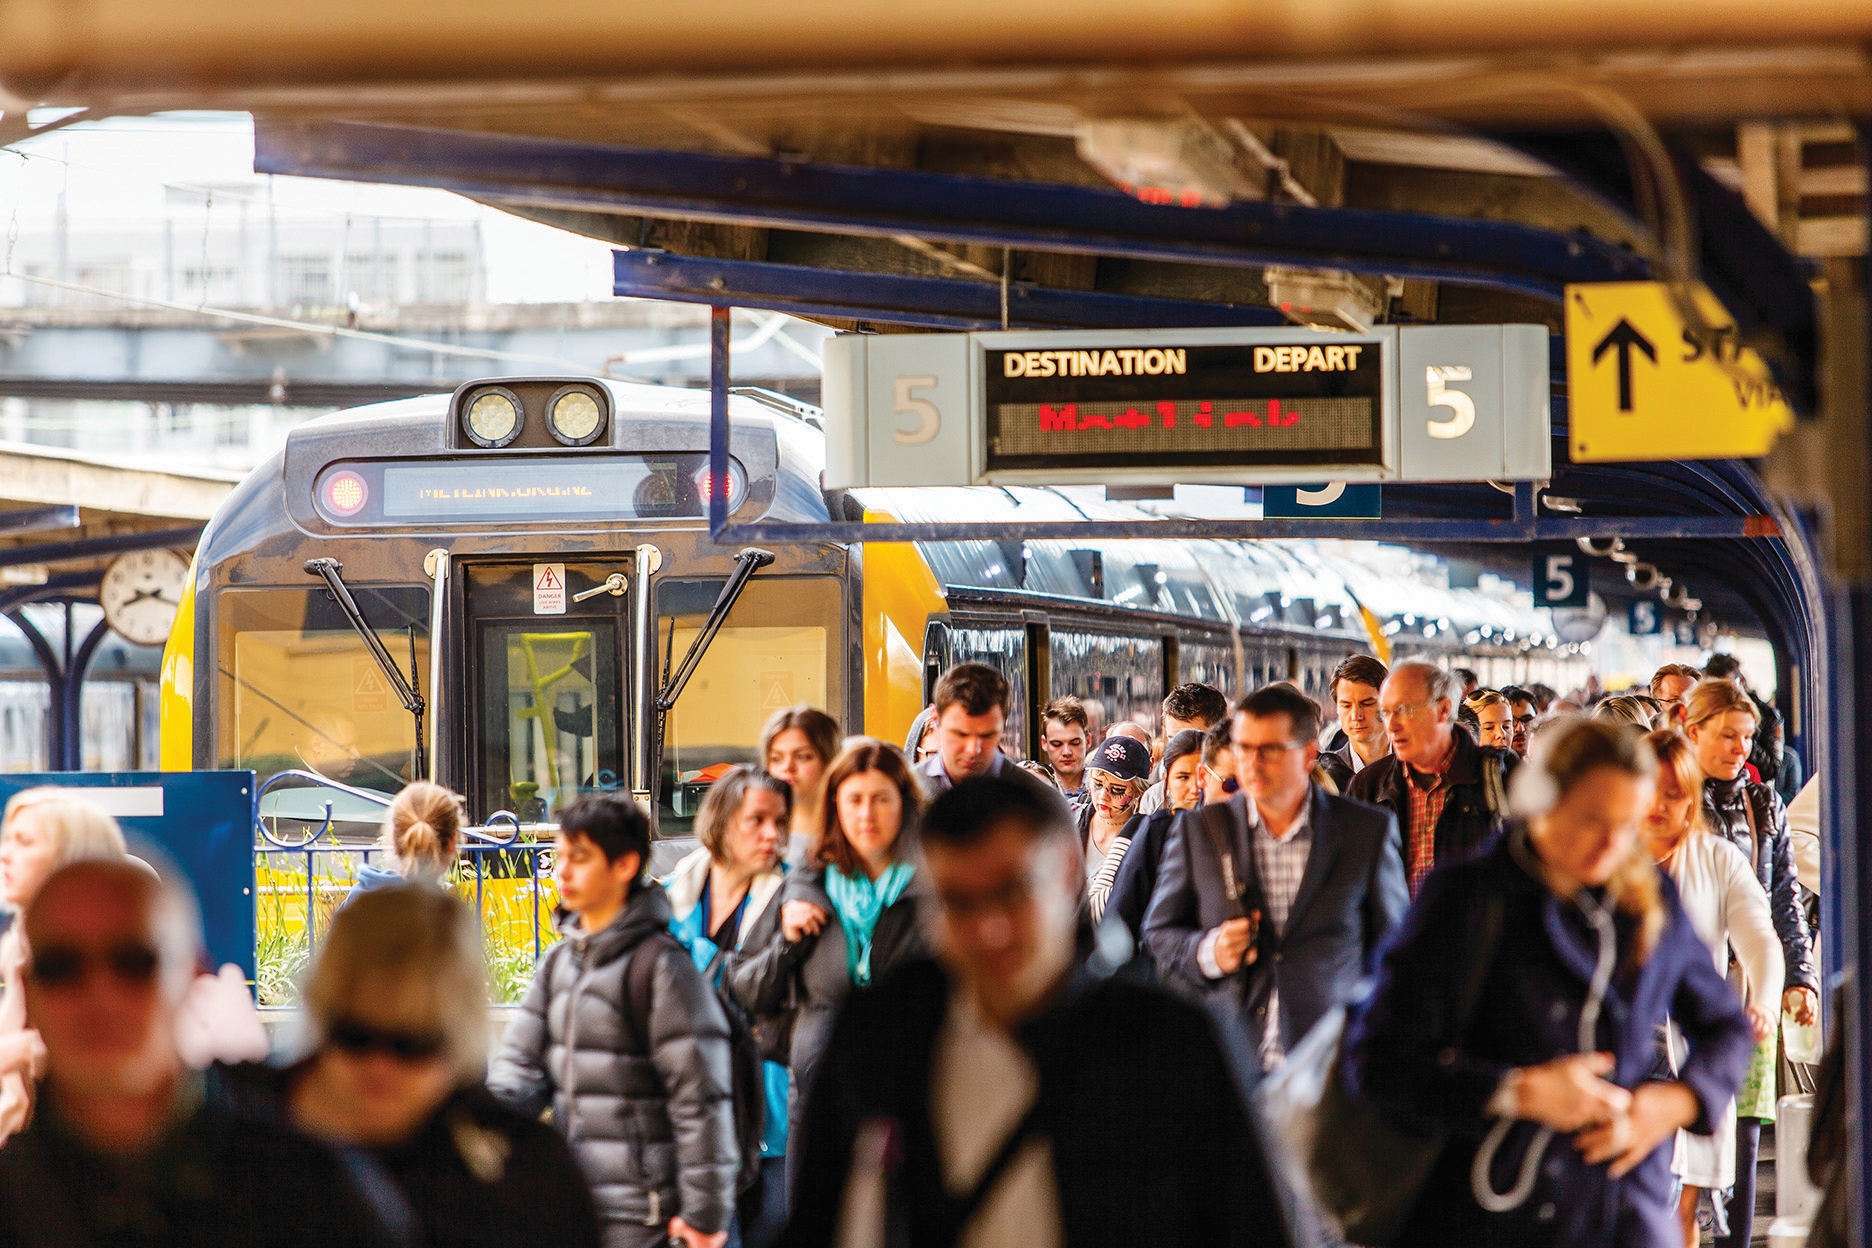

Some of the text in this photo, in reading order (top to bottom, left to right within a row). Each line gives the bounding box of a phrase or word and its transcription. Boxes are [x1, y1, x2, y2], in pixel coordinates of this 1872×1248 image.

[1003, 345, 1363, 378] DESTINATION DEPART
[894, 374, 941, 446] 5
[1426, 365, 1476, 439] 5
[1546, 555, 1574, 601] 5
